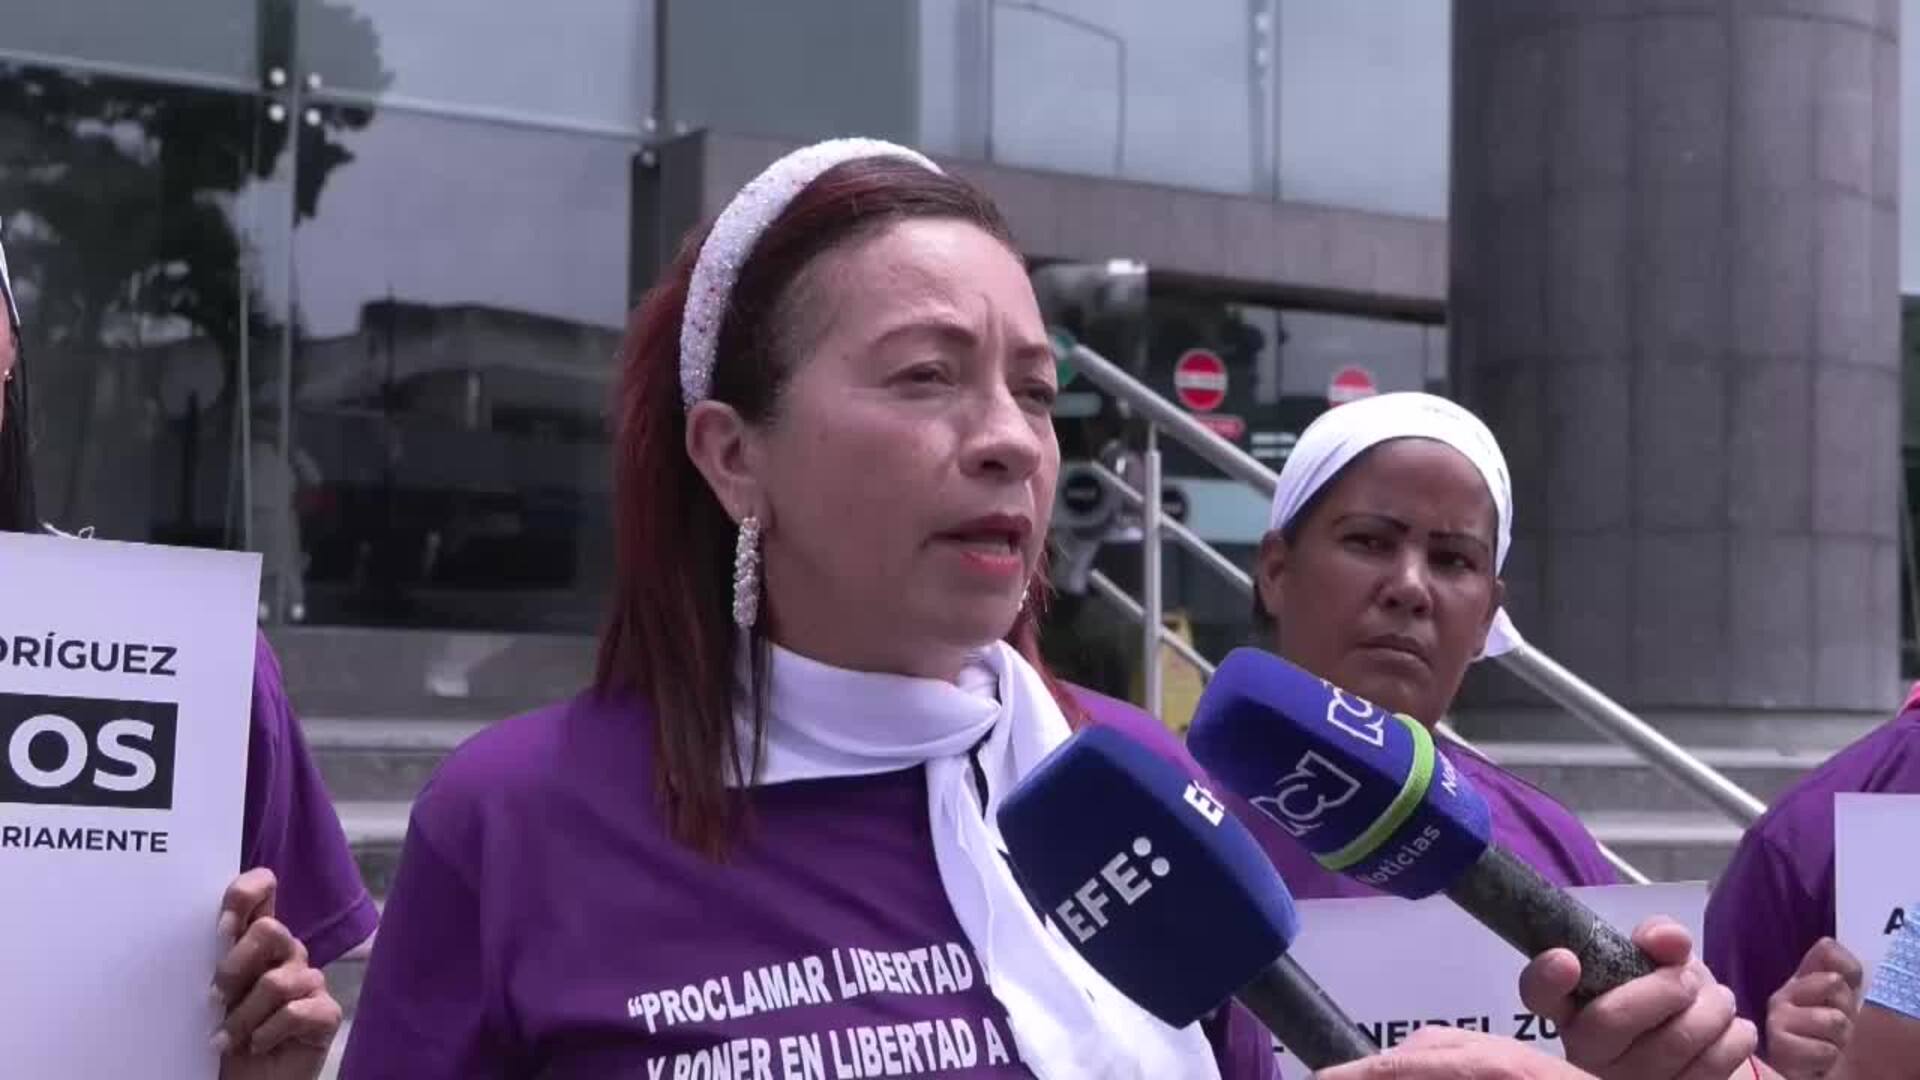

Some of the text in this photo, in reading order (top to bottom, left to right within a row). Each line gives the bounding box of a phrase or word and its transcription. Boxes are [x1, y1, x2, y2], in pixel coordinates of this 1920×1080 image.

[8, 714, 157, 792] OS
[2, 826, 169, 853] RIAMENTE
[831, 941, 973, 1000] LIBERTAD
[779, 1033, 826, 1080] EN
[828, 1017, 978, 1080] LIBERTAD
[982, 1016, 1010, 1066] A
